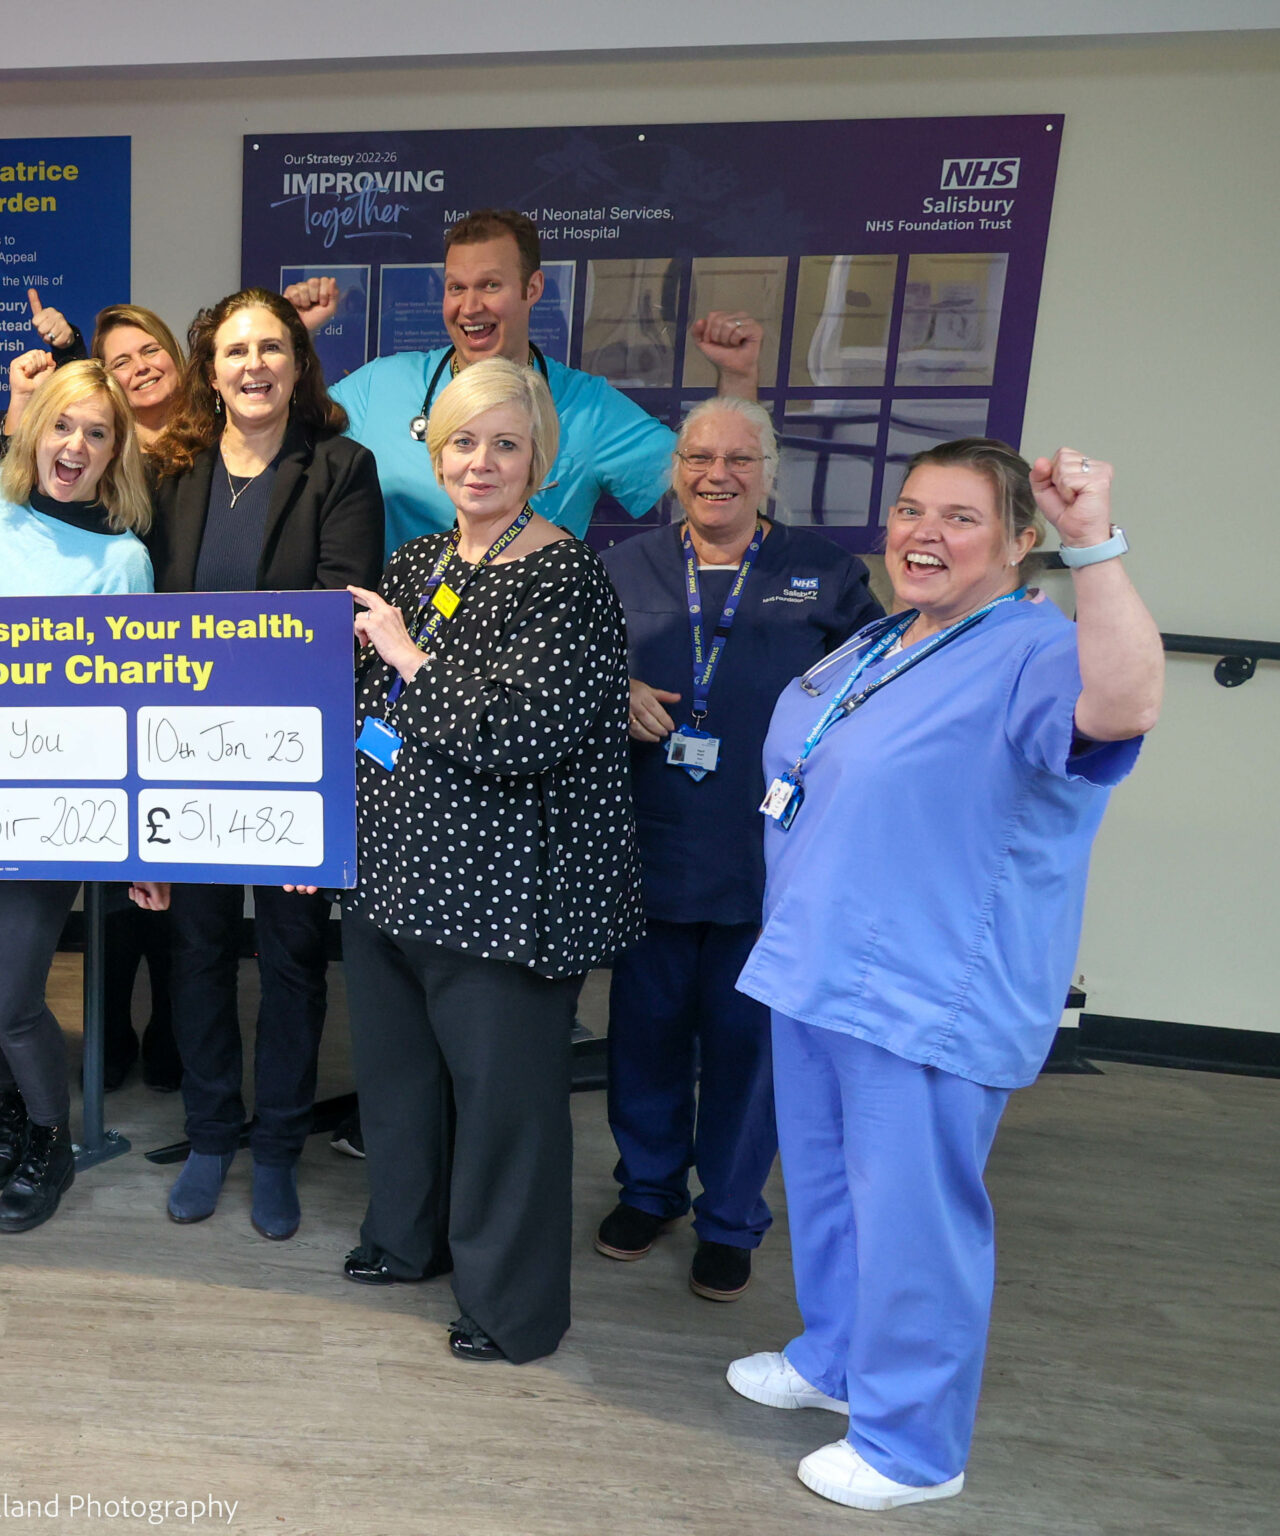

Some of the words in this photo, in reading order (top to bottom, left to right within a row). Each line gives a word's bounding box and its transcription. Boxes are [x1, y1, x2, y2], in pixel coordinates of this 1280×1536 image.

[355, 152, 397, 164] 2022-26
[283, 170, 445, 195] IMPROVING
[943, 160, 1016, 187] NHS
[270, 177, 410, 248] Together
[542, 207, 605, 221] Neonatal
[609, 206, 674, 222] Services,
[922, 196, 1014, 216] Salisbury
[563, 226, 620, 242] Hospital
[866, 220, 894, 232] NHS
[898, 219, 974, 231] Foundation
[979, 218, 1012, 230] Trust
[4, 236, 15, 246] to
[2, 276, 20, 286] the
[22, 275, 49, 286] Wills
[52, 274, 64, 286] of
[324, 324, 343, 336] did
[488, 524, 522, 559] APPEAL
[433, 542, 456, 577] APPEAL
[793, 579, 817, 588] NHS
[105, 616, 180, 640] Your
[191, 613, 315, 643] Health,
[65, 653, 214, 691] Charity
[10, 718, 64, 760] You
[146, 718, 195, 764] 10th
[199, 720, 251, 762] Jan
[40, 796, 123, 846] 2022
